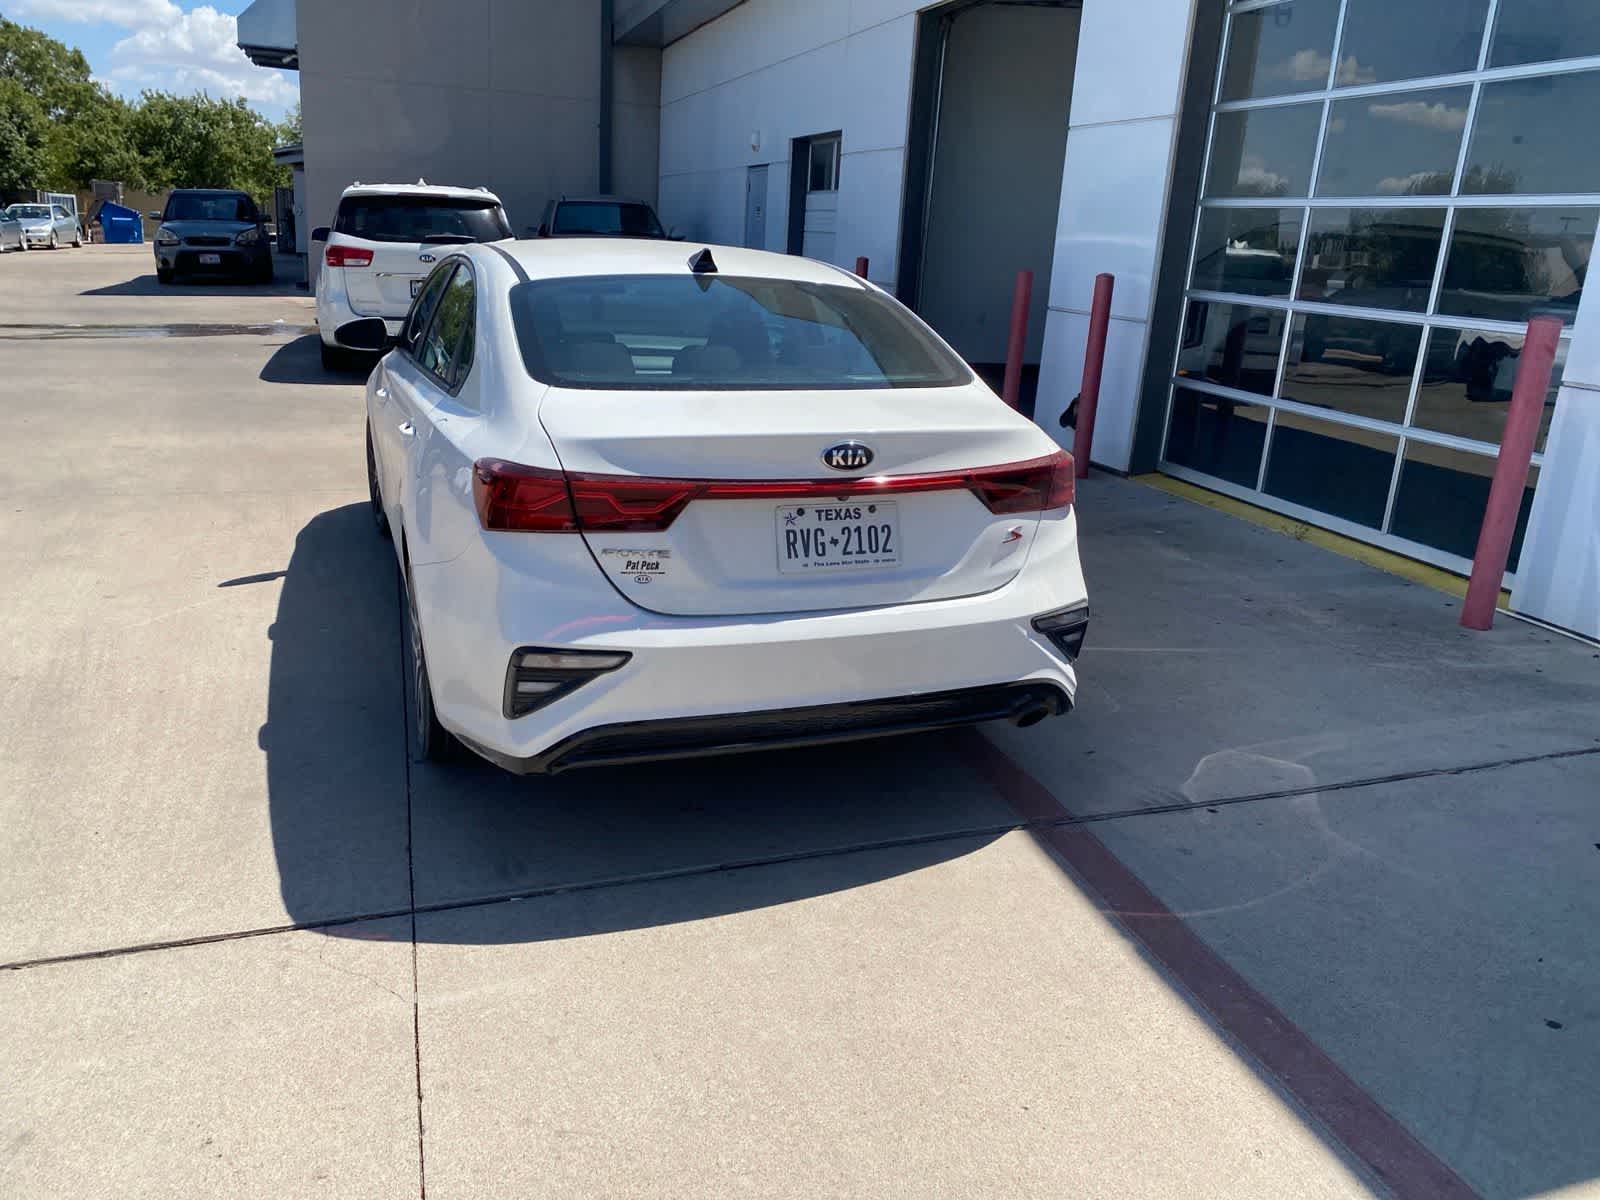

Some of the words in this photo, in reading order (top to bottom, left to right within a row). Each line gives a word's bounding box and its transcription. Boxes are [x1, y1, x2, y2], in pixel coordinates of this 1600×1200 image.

[832, 449, 867, 466] KIA
[815, 507, 862, 521] TEXAS
[785, 528, 827, 559] RVG
[841, 524, 893, 556] 2102
[625, 560, 639, 570] Pat
[641, 560, 660, 570] Peck
